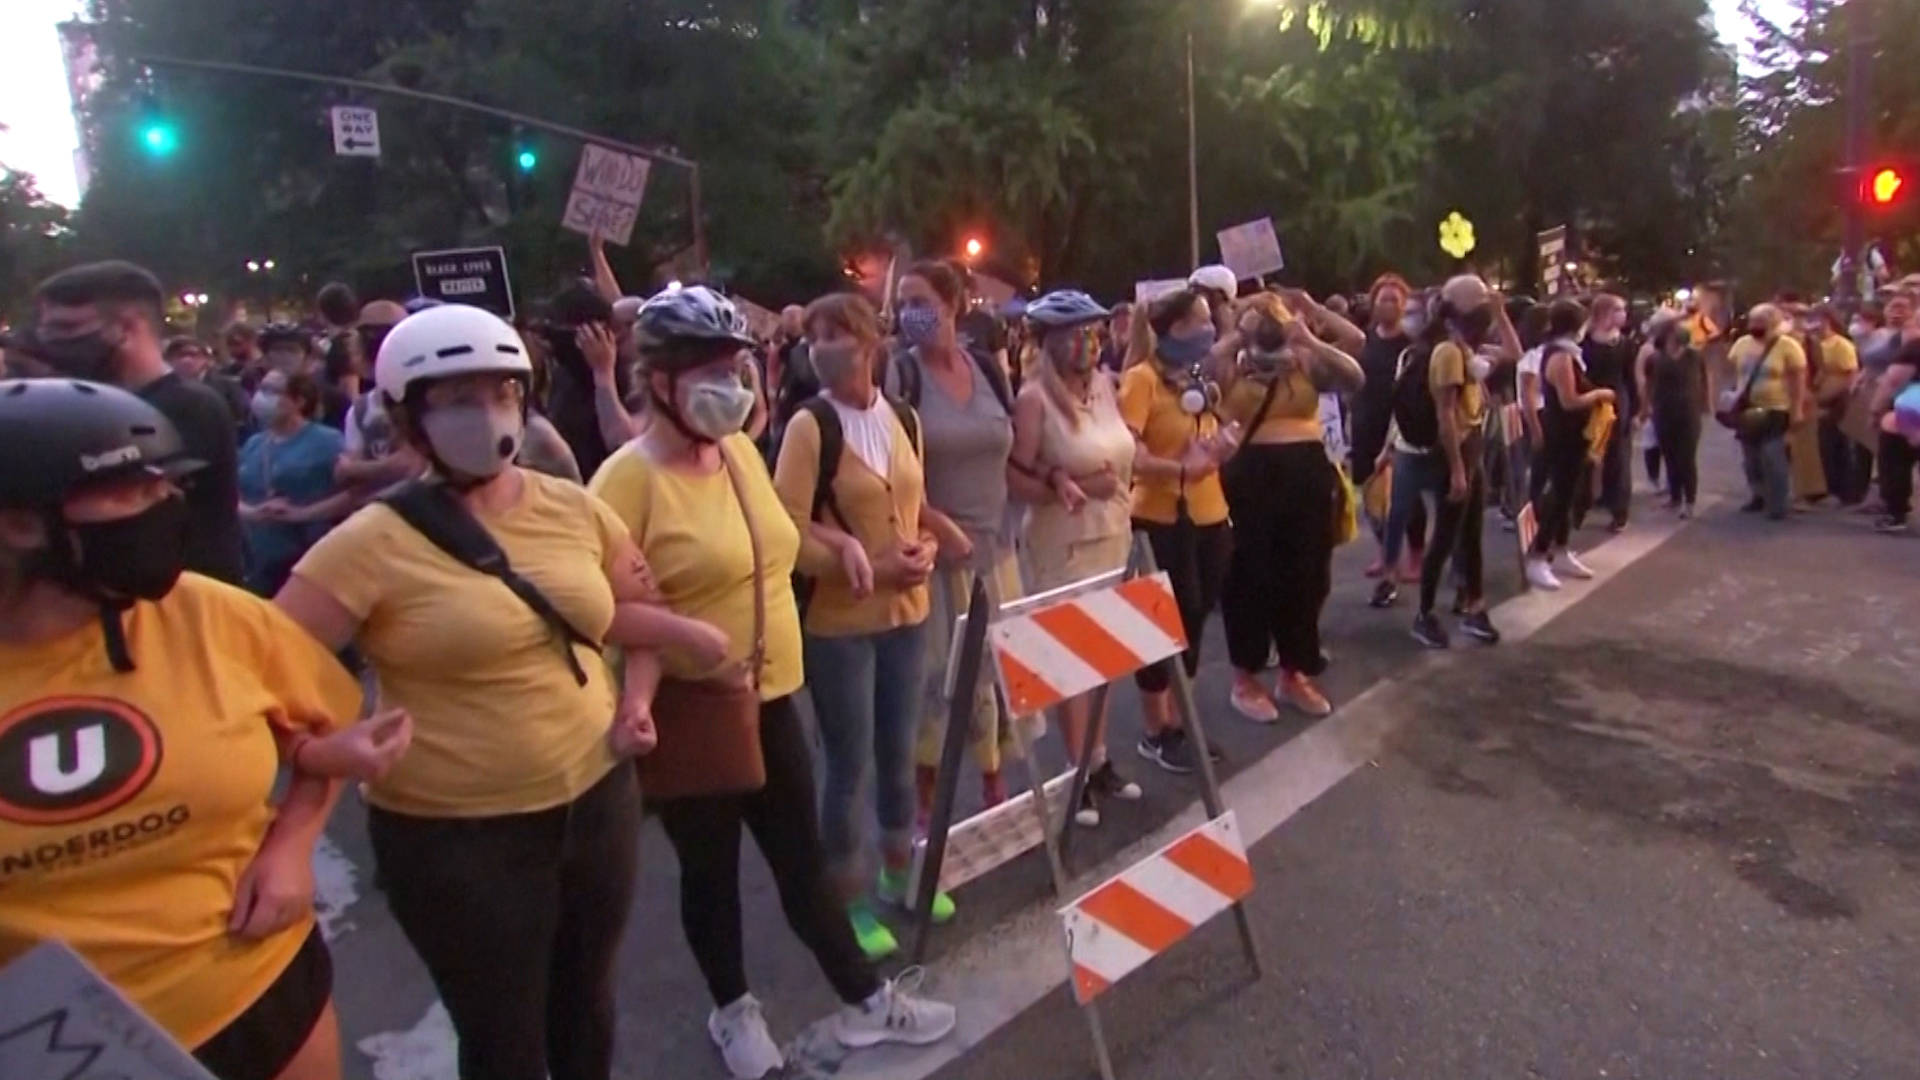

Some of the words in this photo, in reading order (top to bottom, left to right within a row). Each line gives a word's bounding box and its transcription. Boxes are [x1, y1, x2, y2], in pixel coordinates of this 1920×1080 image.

[340, 110, 373, 123] ONE
[341, 124, 374, 134] WAY
[29, 723, 106, 795] U
[2, 804, 191, 874] NDERDOG
